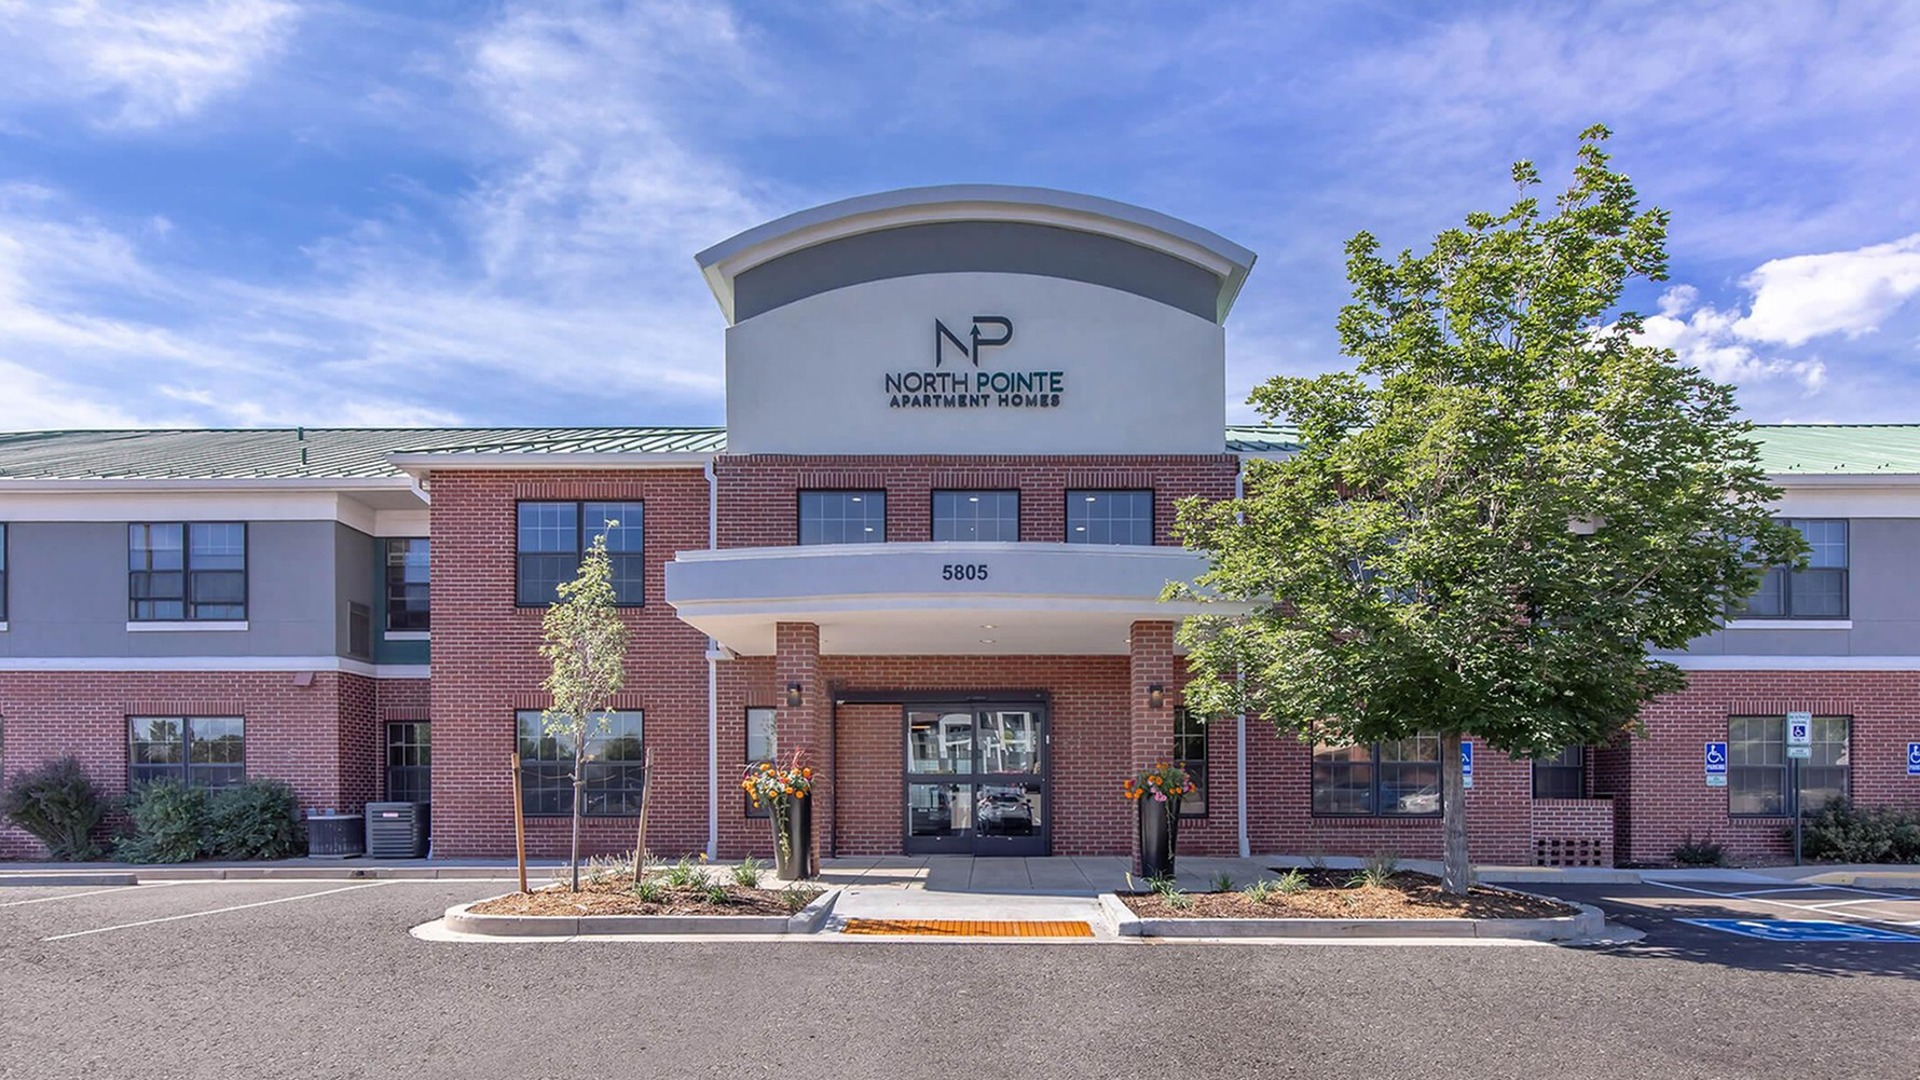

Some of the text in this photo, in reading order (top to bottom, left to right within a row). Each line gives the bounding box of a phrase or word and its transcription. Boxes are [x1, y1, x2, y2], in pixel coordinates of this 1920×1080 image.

[935, 316, 1013, 368] NP
[885, 372, 1064, 393] NORTH POINTE
[890, 394, 1060, 408] APARTMENT HOMES
[942, 564, 988, 580] 5805
